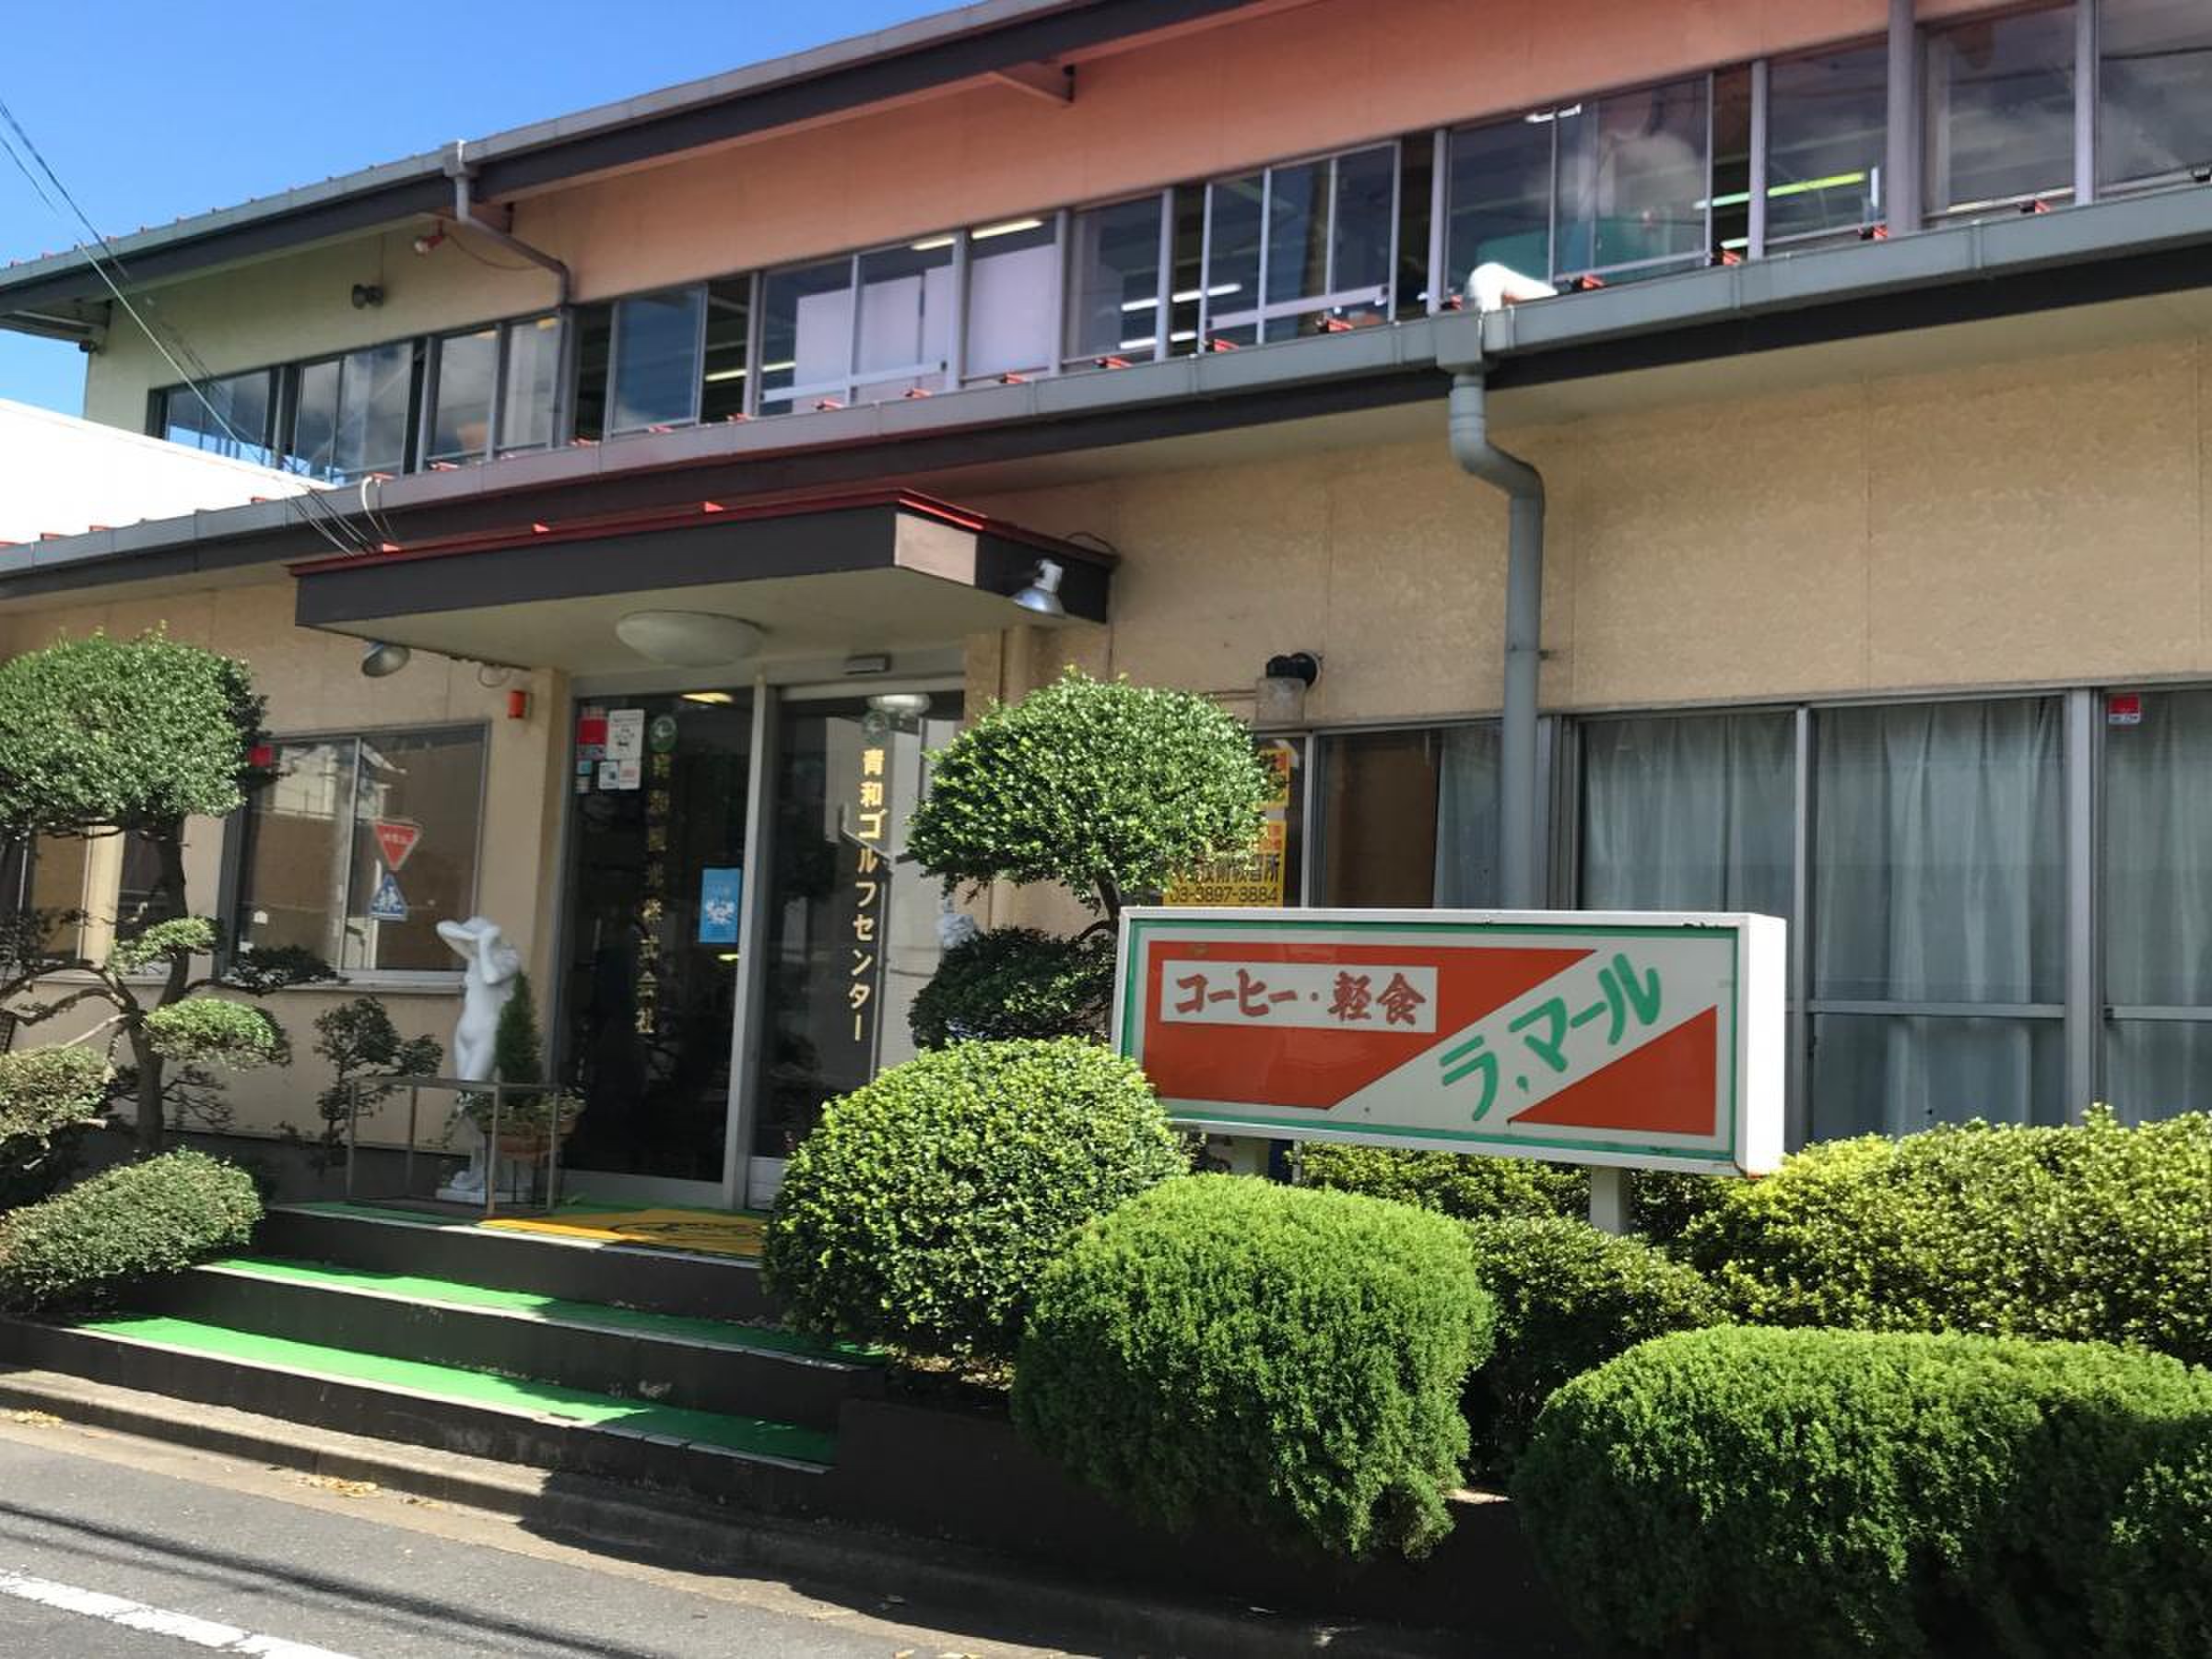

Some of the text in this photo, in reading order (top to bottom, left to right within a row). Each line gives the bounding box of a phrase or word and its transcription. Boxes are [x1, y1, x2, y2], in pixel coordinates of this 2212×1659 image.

[849, 748, 888, 1041] 青和ゴルフセンター
[1174, 968, 1427, 1025] コーヒー・軽食
